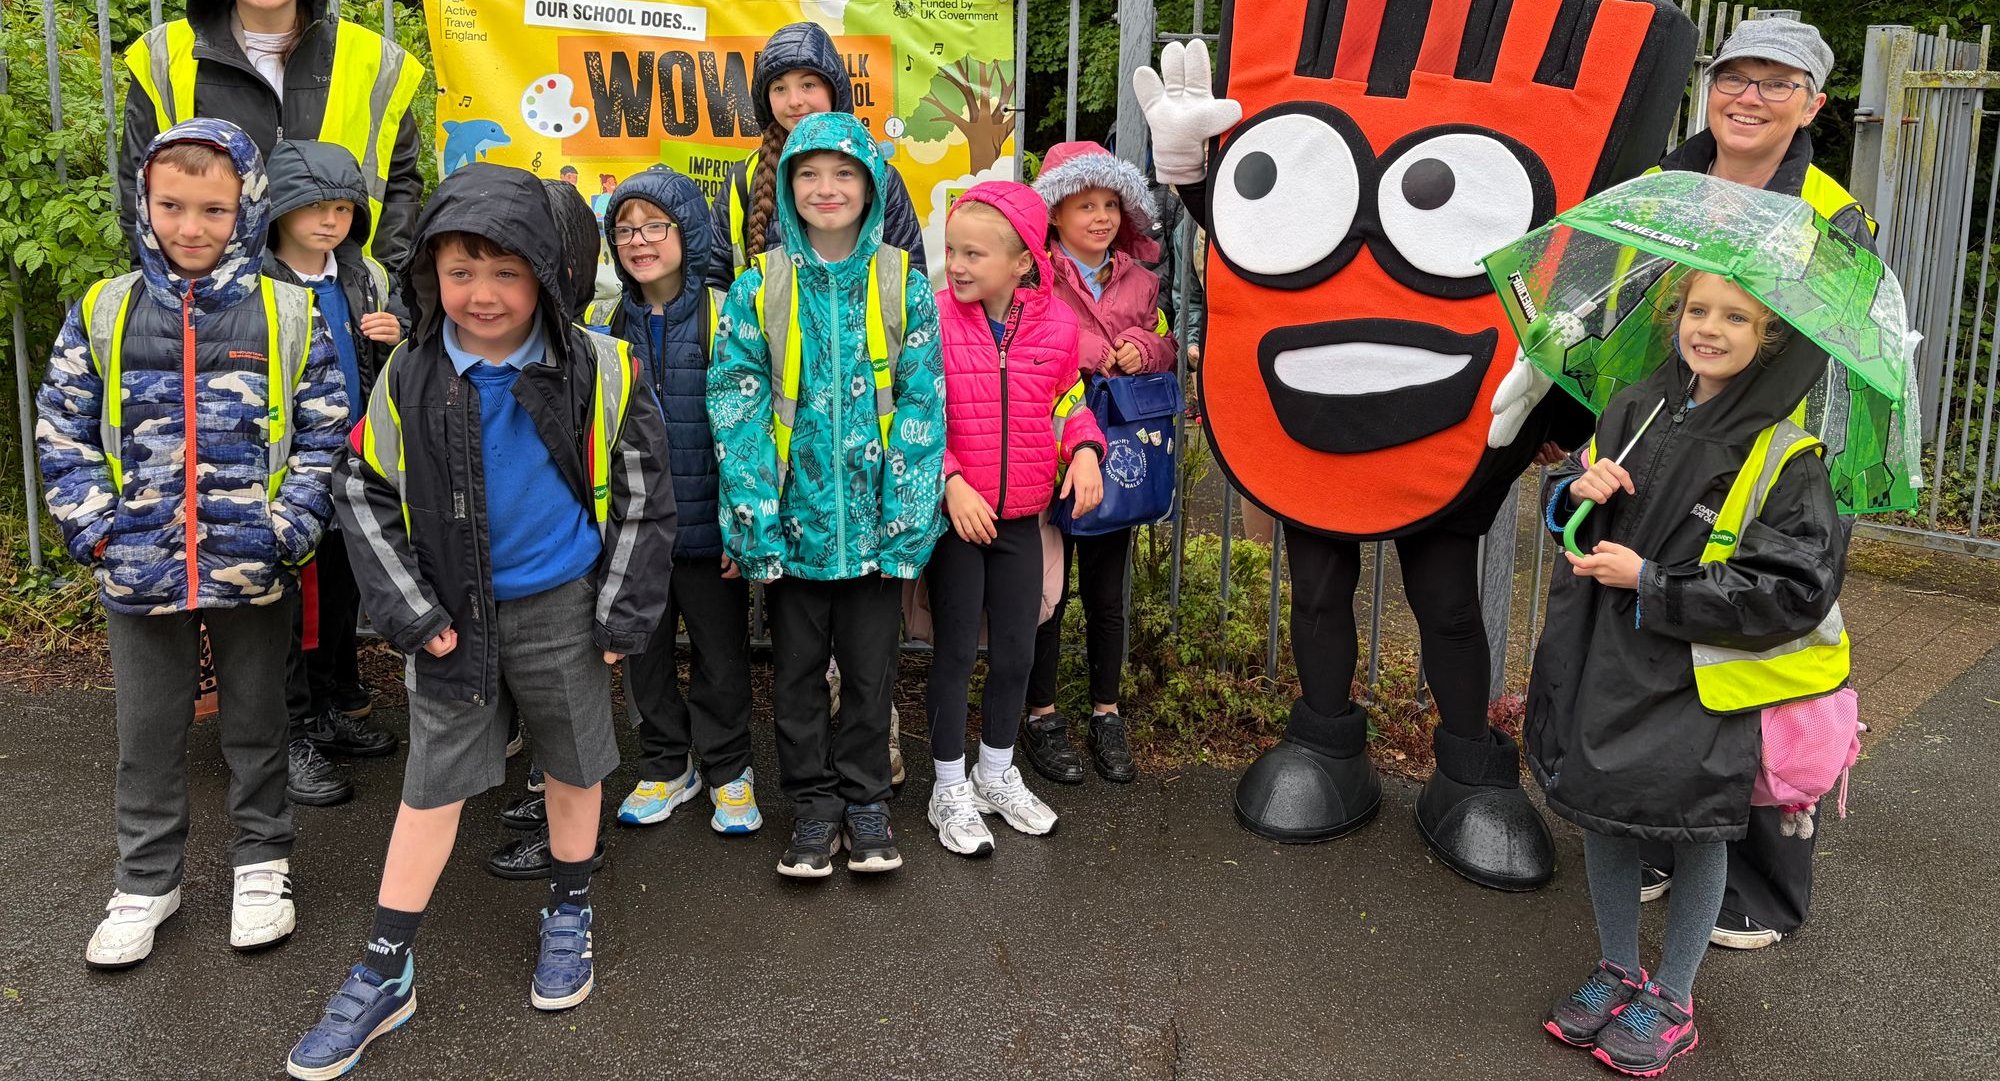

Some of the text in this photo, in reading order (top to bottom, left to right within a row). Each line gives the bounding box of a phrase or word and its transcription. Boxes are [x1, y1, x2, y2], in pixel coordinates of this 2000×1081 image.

[445, 5, 477, 17] Active
[920, 0, 974, 11] Funded by
[535, 0, 697, 32] OUR SCHOOL DOES...
[920, 10, 999, 21] UK Government
[445, 17, 475, 29] Travel
[445, 29, 488, 42] England
[689, 156, 735, 178] IMPRO
[1608, 219, 1703, 252] MINECRAFT
[1692, 503, 1719, 520] EGATT
